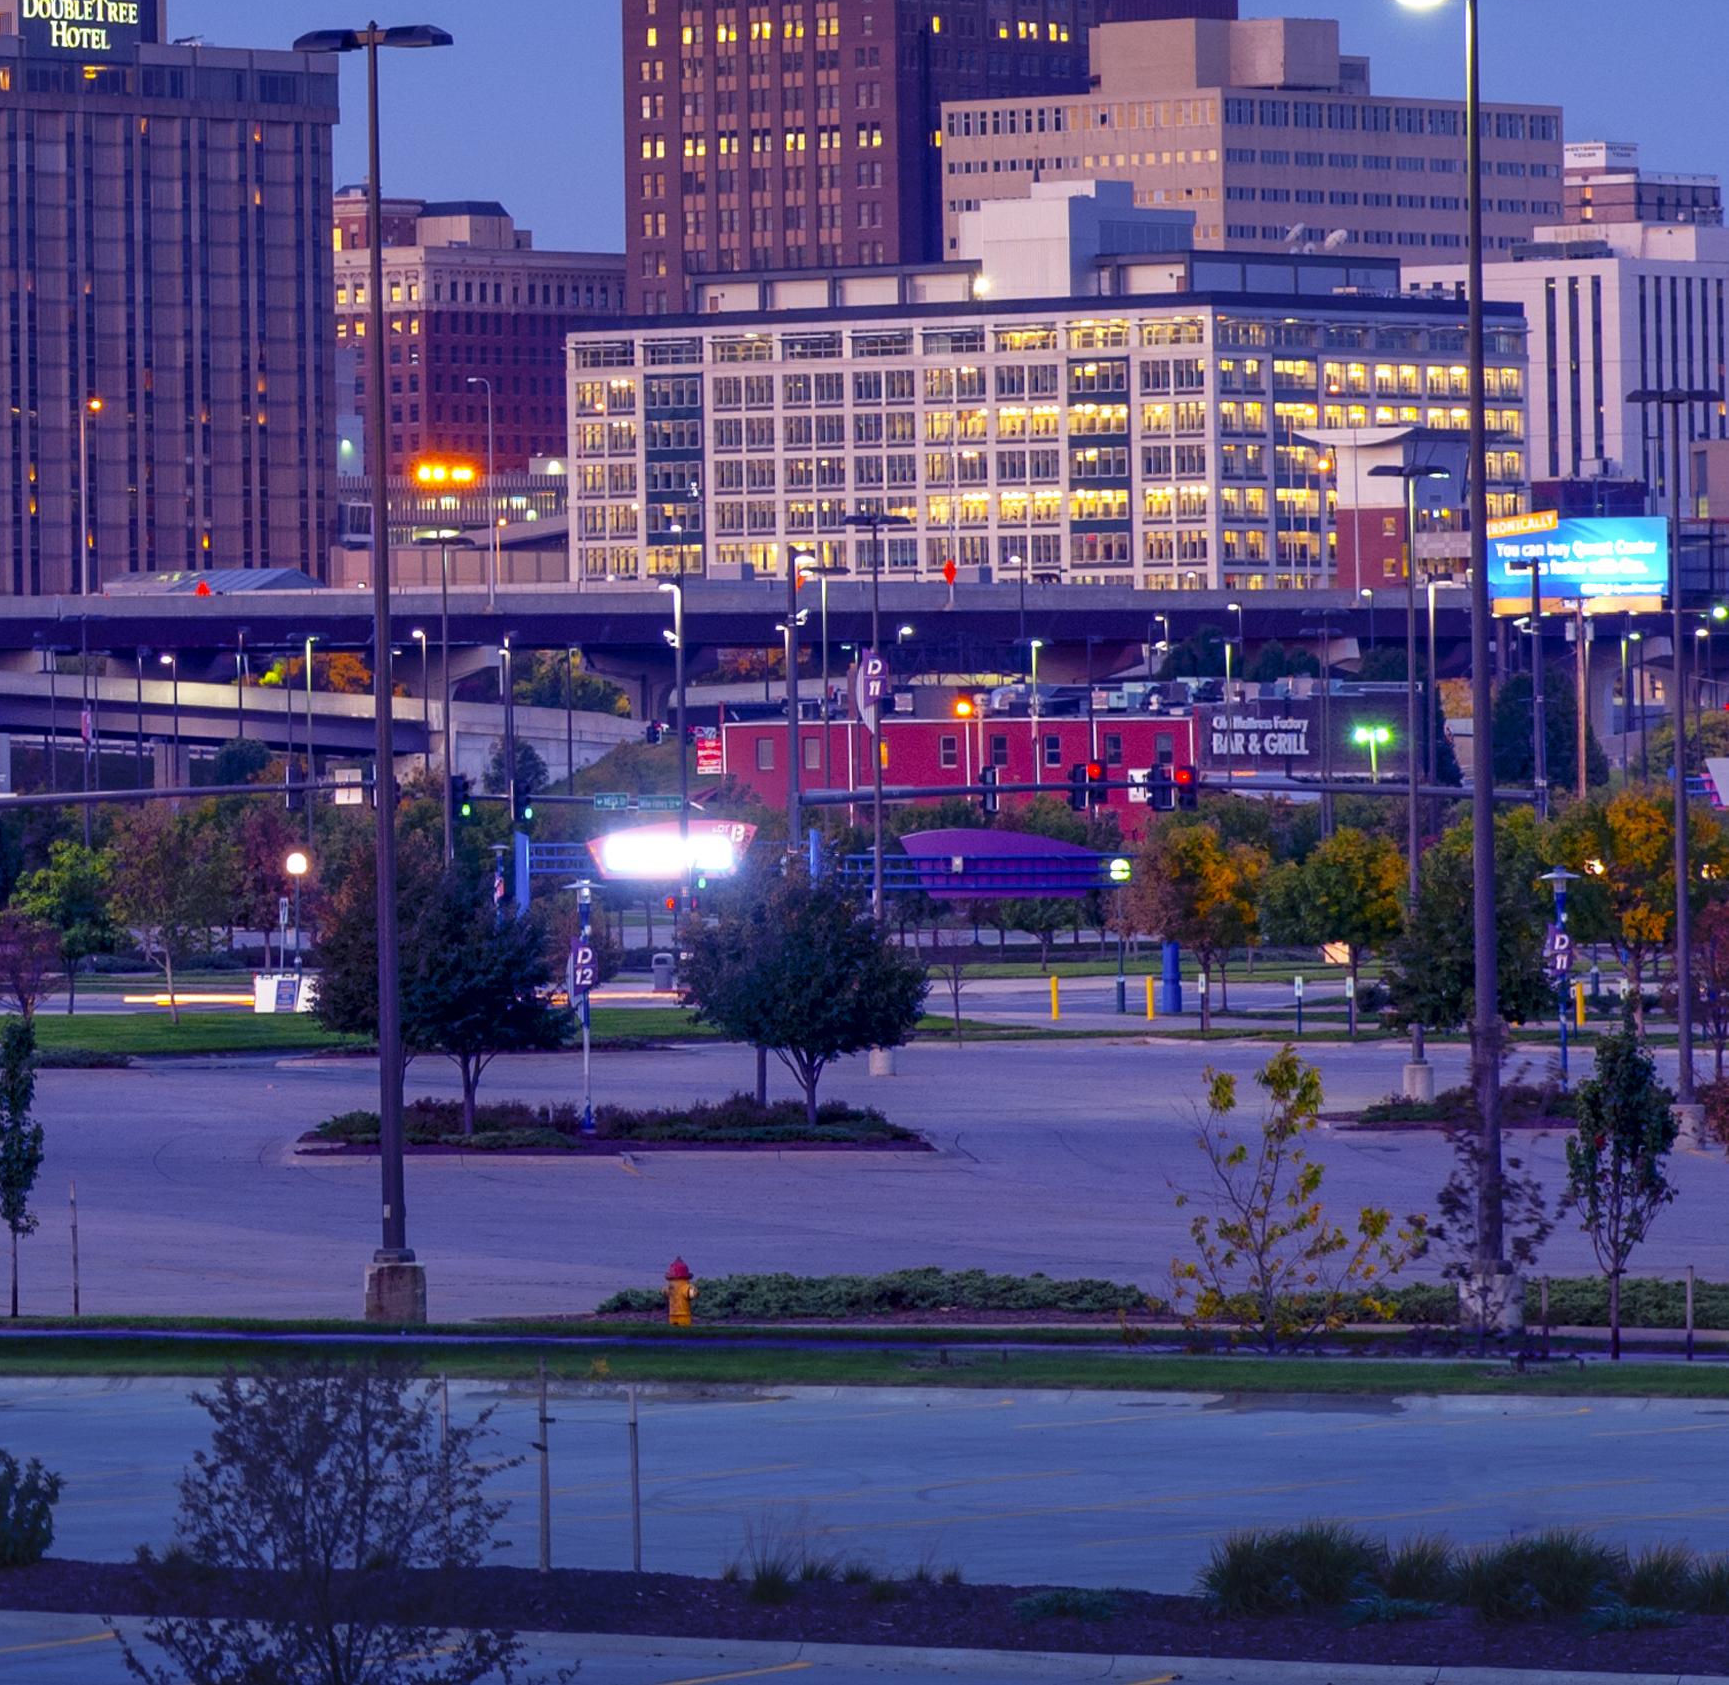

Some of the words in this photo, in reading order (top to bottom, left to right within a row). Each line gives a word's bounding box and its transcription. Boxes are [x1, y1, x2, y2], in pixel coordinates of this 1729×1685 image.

[50, 20, 112, 50] HOTEL
[867, 658, 882, 675] D
[1212, 733, 1245, 755] BAR
[1248, 733, 1261, 755] &
[1264, 733, 1310, 755] GRILL
[576, 946, 593, 965] D
[575, 968, 594, 985] 12
